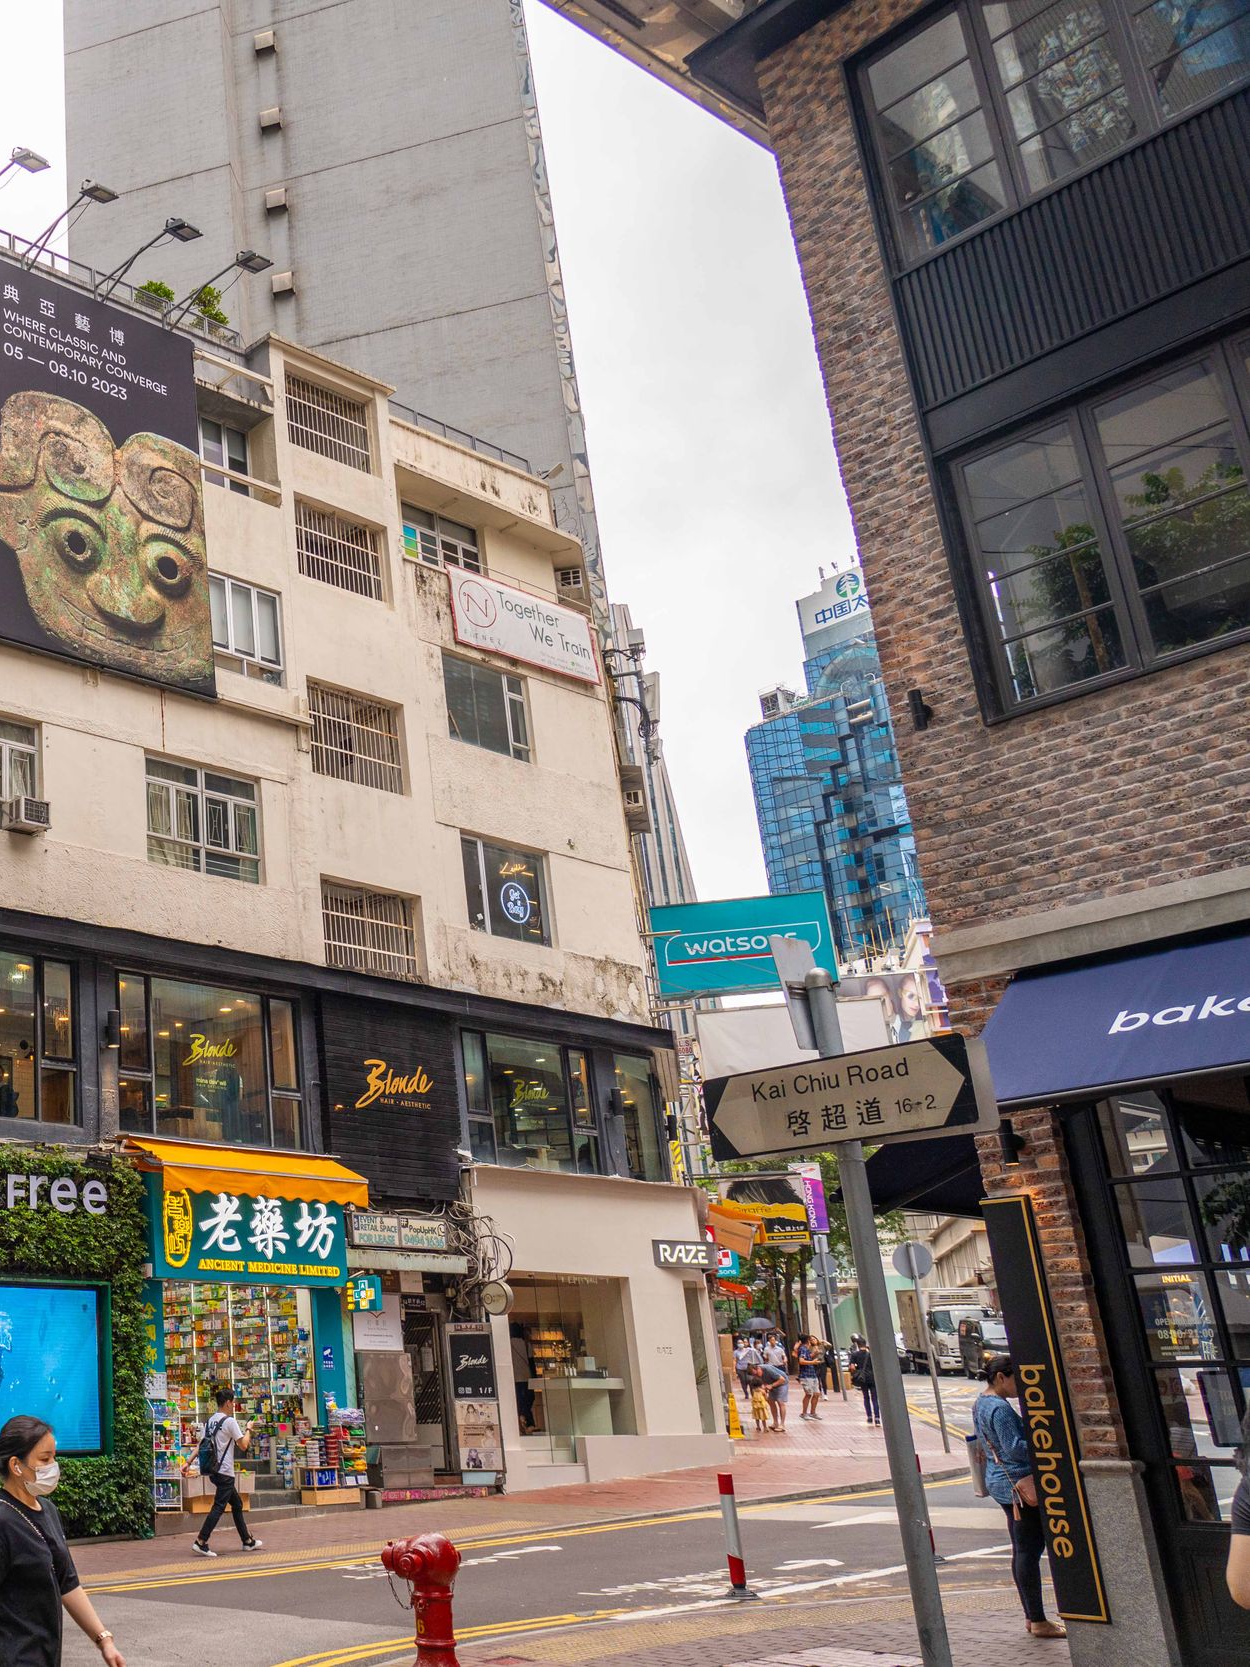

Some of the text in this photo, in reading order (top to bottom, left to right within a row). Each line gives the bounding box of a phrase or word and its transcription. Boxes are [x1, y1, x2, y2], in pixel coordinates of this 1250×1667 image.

[3, 308, 127, 366] WHERE CLASSIC AND
[3, 323, 168, 396] CONTEMPORARY CONVERGE
[3, 342, 24, 361] 05
[50, 360, 88, 385] 08.10
[91, 376, 128, 400] 2023
[496, 590, 559, 628] Together
[528, 623, 591, 660] We Train
[685, 932, 798, 956] watso
[182, 1033, 238, 1066] Blonde
[355, 1059, 434, 1109] Blonde
[752, 1057, 910, 1103] Kai Chiu Road
[400, 1100, 432, 1110] AESTHETIC
[359, 1215, 377, 1224] EVENT
[803, 1180, 817, 1228] HONG KONG
[198, 1192, 338, 1261] 老藥坊
[360, 1224, 398, 1233] RETAIL SPACE
[198, 1258, 341, 1278] ANCIENT MEDICINE LIMITED
[659, 1244, 709, 1264] RAZE
[1161, 1274, 1193, 1284] INITIAL
[455, 1354, 489, 1371] Blonde
[1019, 1363, 1074, 1560] bakehouse
[417, 1618, 425, 1635] 6
